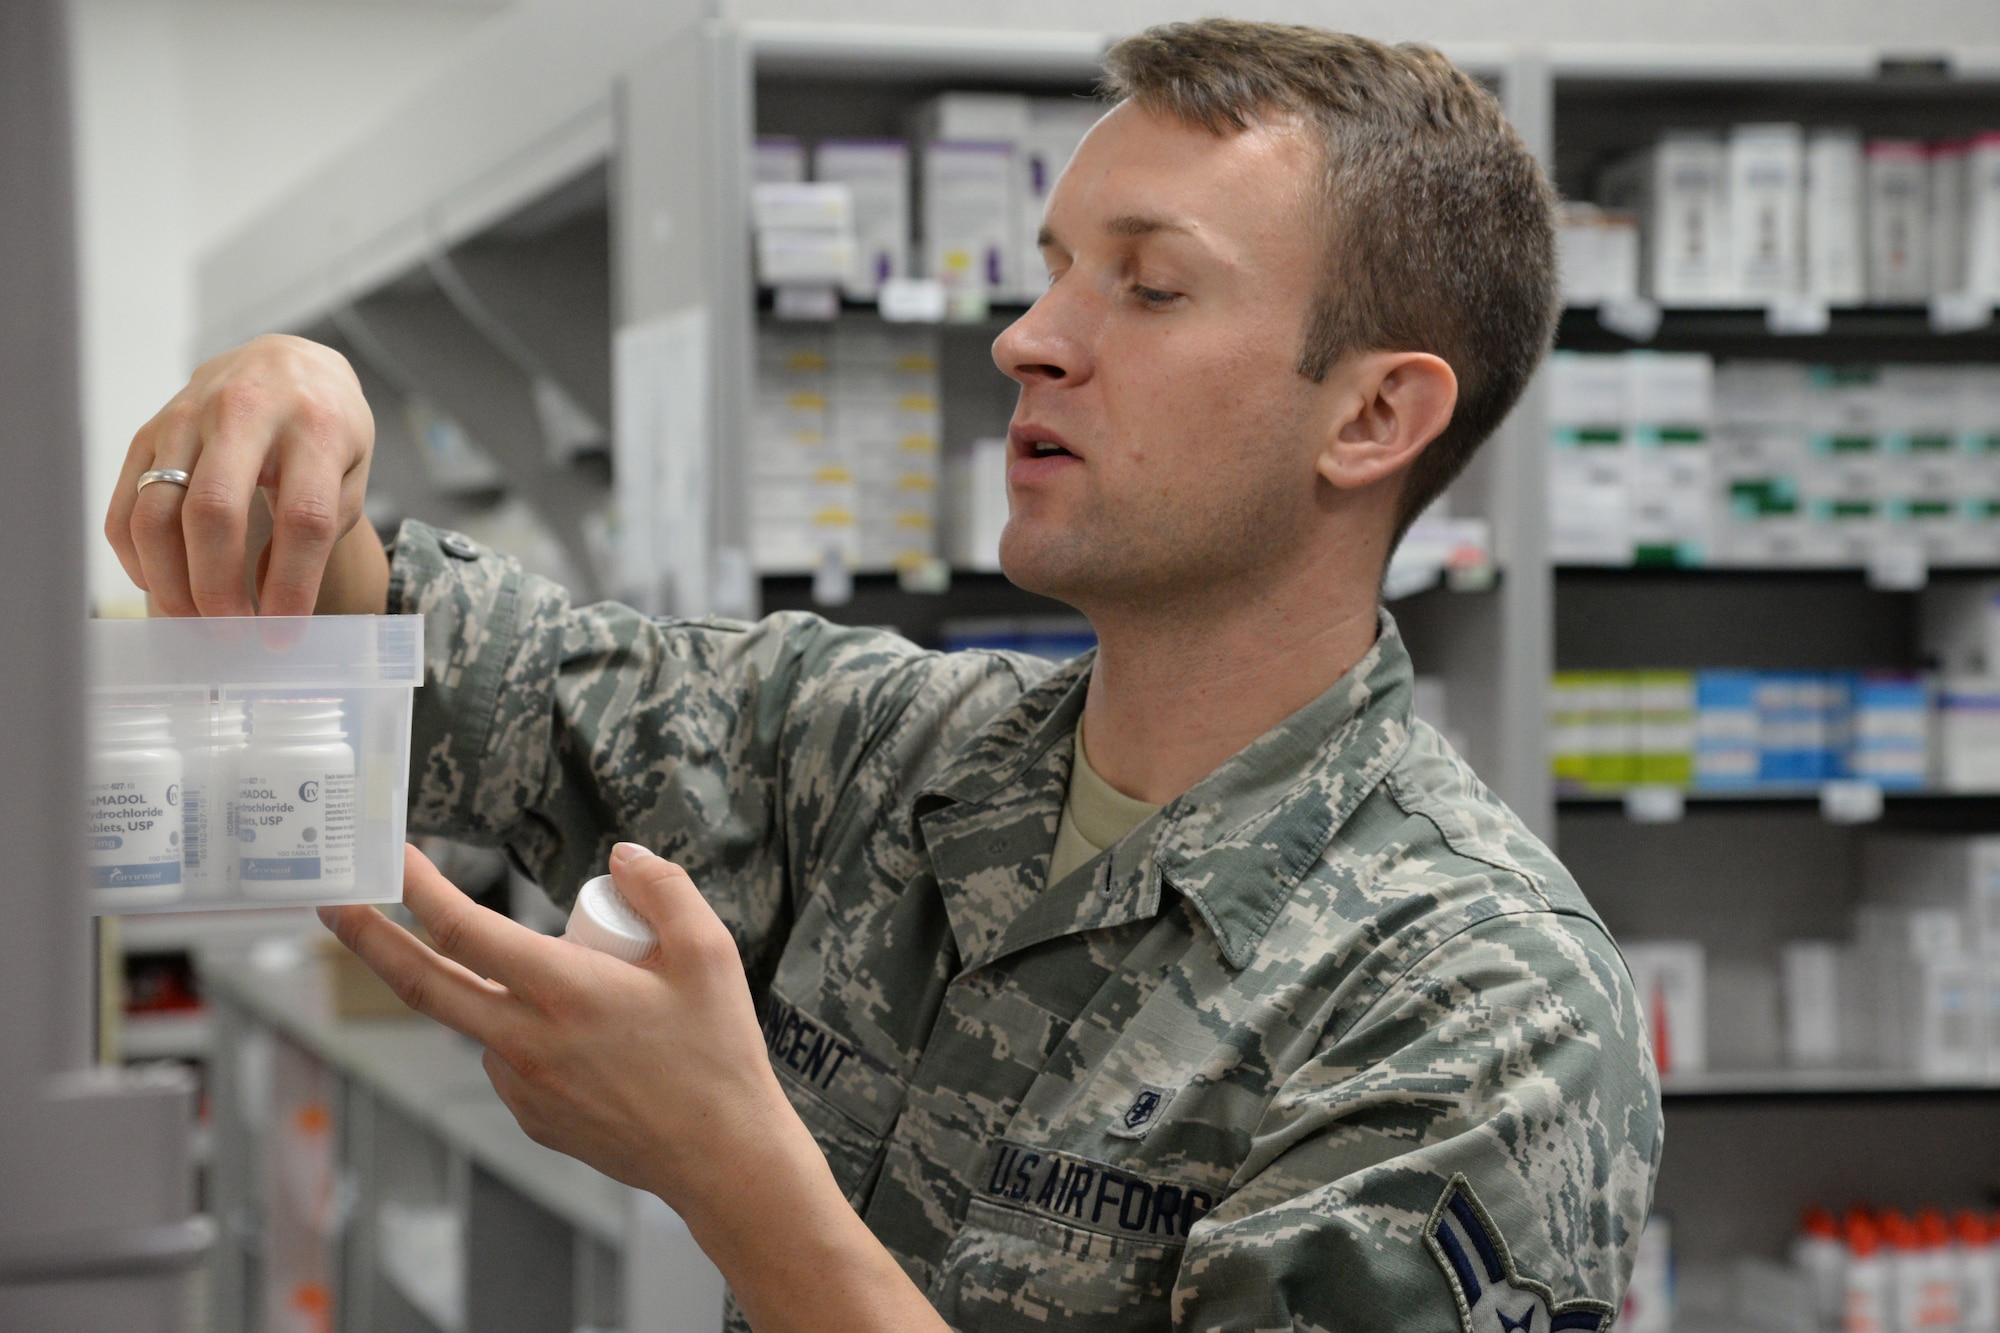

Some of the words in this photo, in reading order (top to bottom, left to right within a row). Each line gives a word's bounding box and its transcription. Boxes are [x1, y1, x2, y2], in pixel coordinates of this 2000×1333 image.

[127, 820, 154, 832] USP
[260, 815, 283, 826] USP
[1036, 1157, 1094, 1219] AIR
[1091, 1170, 1224, 1239] FORC
